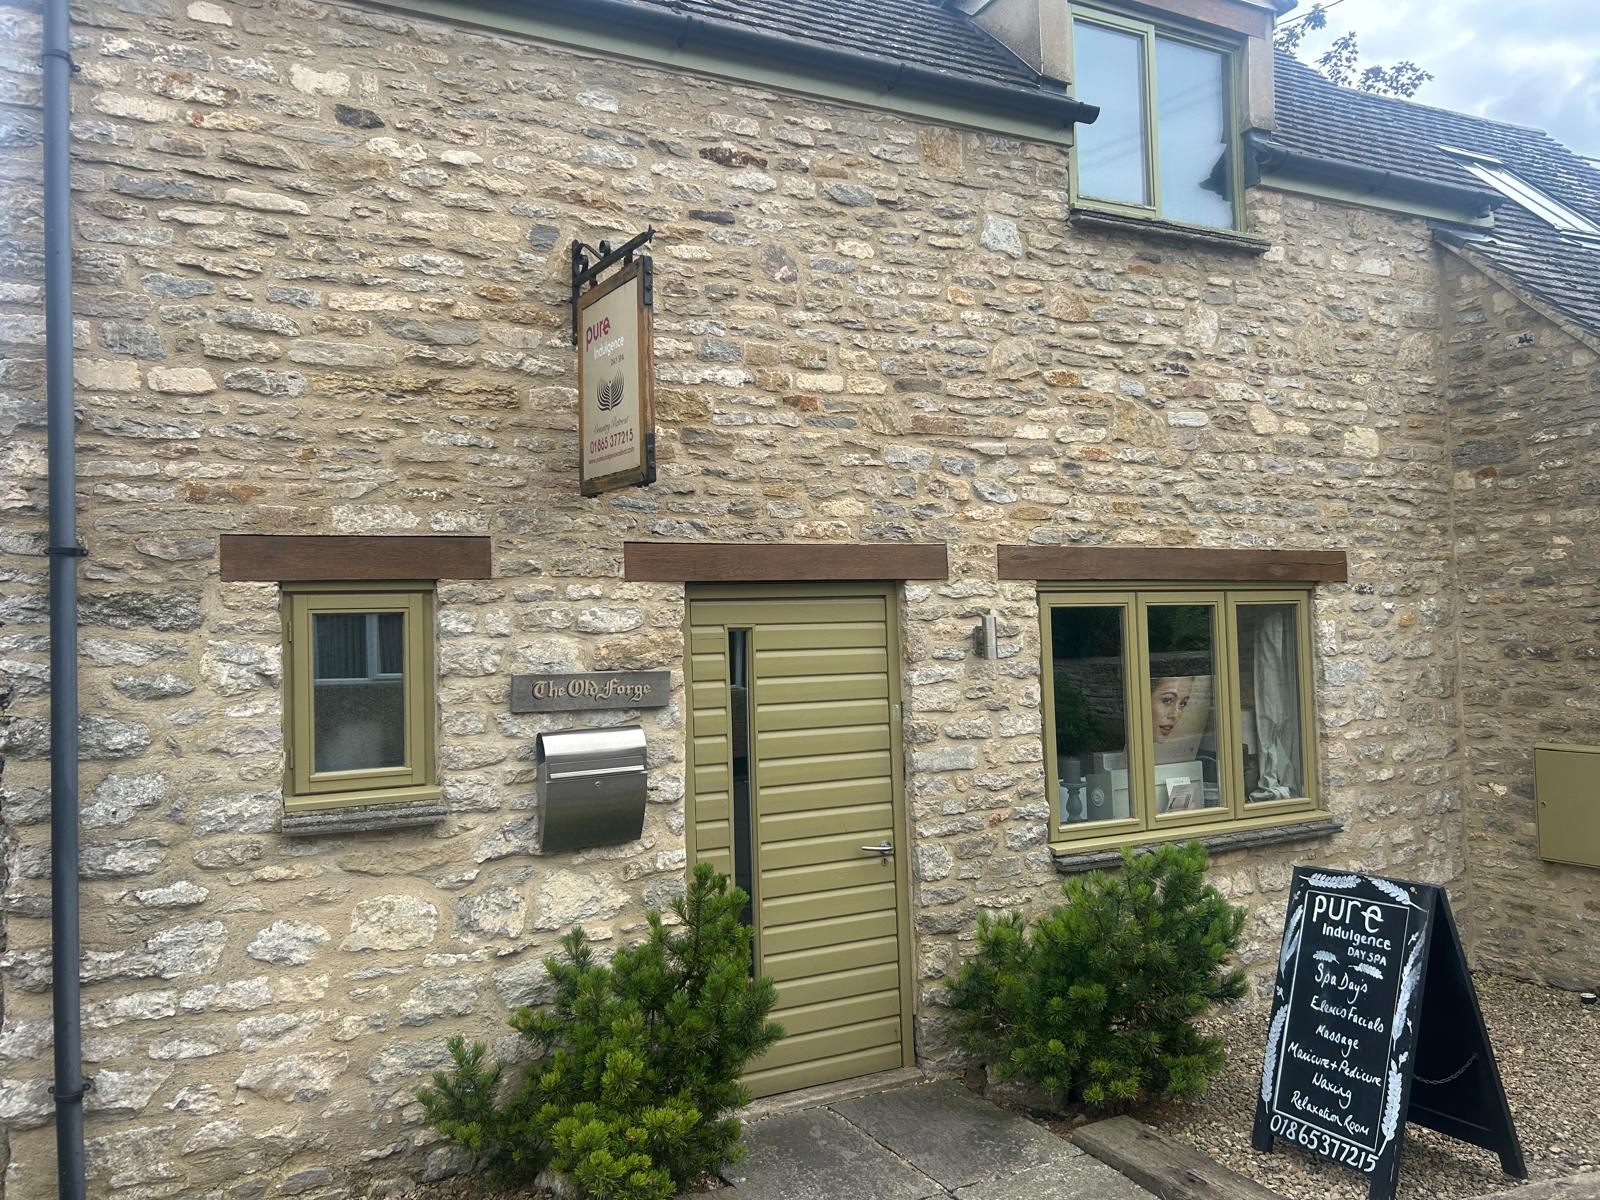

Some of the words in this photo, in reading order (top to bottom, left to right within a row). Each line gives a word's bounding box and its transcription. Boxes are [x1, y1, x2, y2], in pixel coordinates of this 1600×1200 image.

[586, 316, 611, 353] pure
[593, 335, 625, 361] Indulgence
[589, 436, 609, 454] 01865
[610, 428, 634, 447] 377215
[532, 680, 566, 700] The
[567, 678, 599, 699] Old
[595, 677, 651, 703] Forge
[1312, 894, 1384, 934] pure
[1322, 922, 1392, 951] Indulgence
[1347, 946, 1366, 962] DAY
[1366, 952, 1387, 967] SPA
[1314, 962, 1337, 989] Spa
[1310, 995, 1347, 1019] Elemis
[1347, 1006, 1385, 1033] Facials
[1315, 1024, 1360, 1058] Massage
[1311, 1072, 1353, 1110] Waxing
[1290, 1090, 1343, 1127] Relaxation
[1343, 1114, 1370, 1136] Room
[1269, 1114, 1380, 1173] 01865377215
